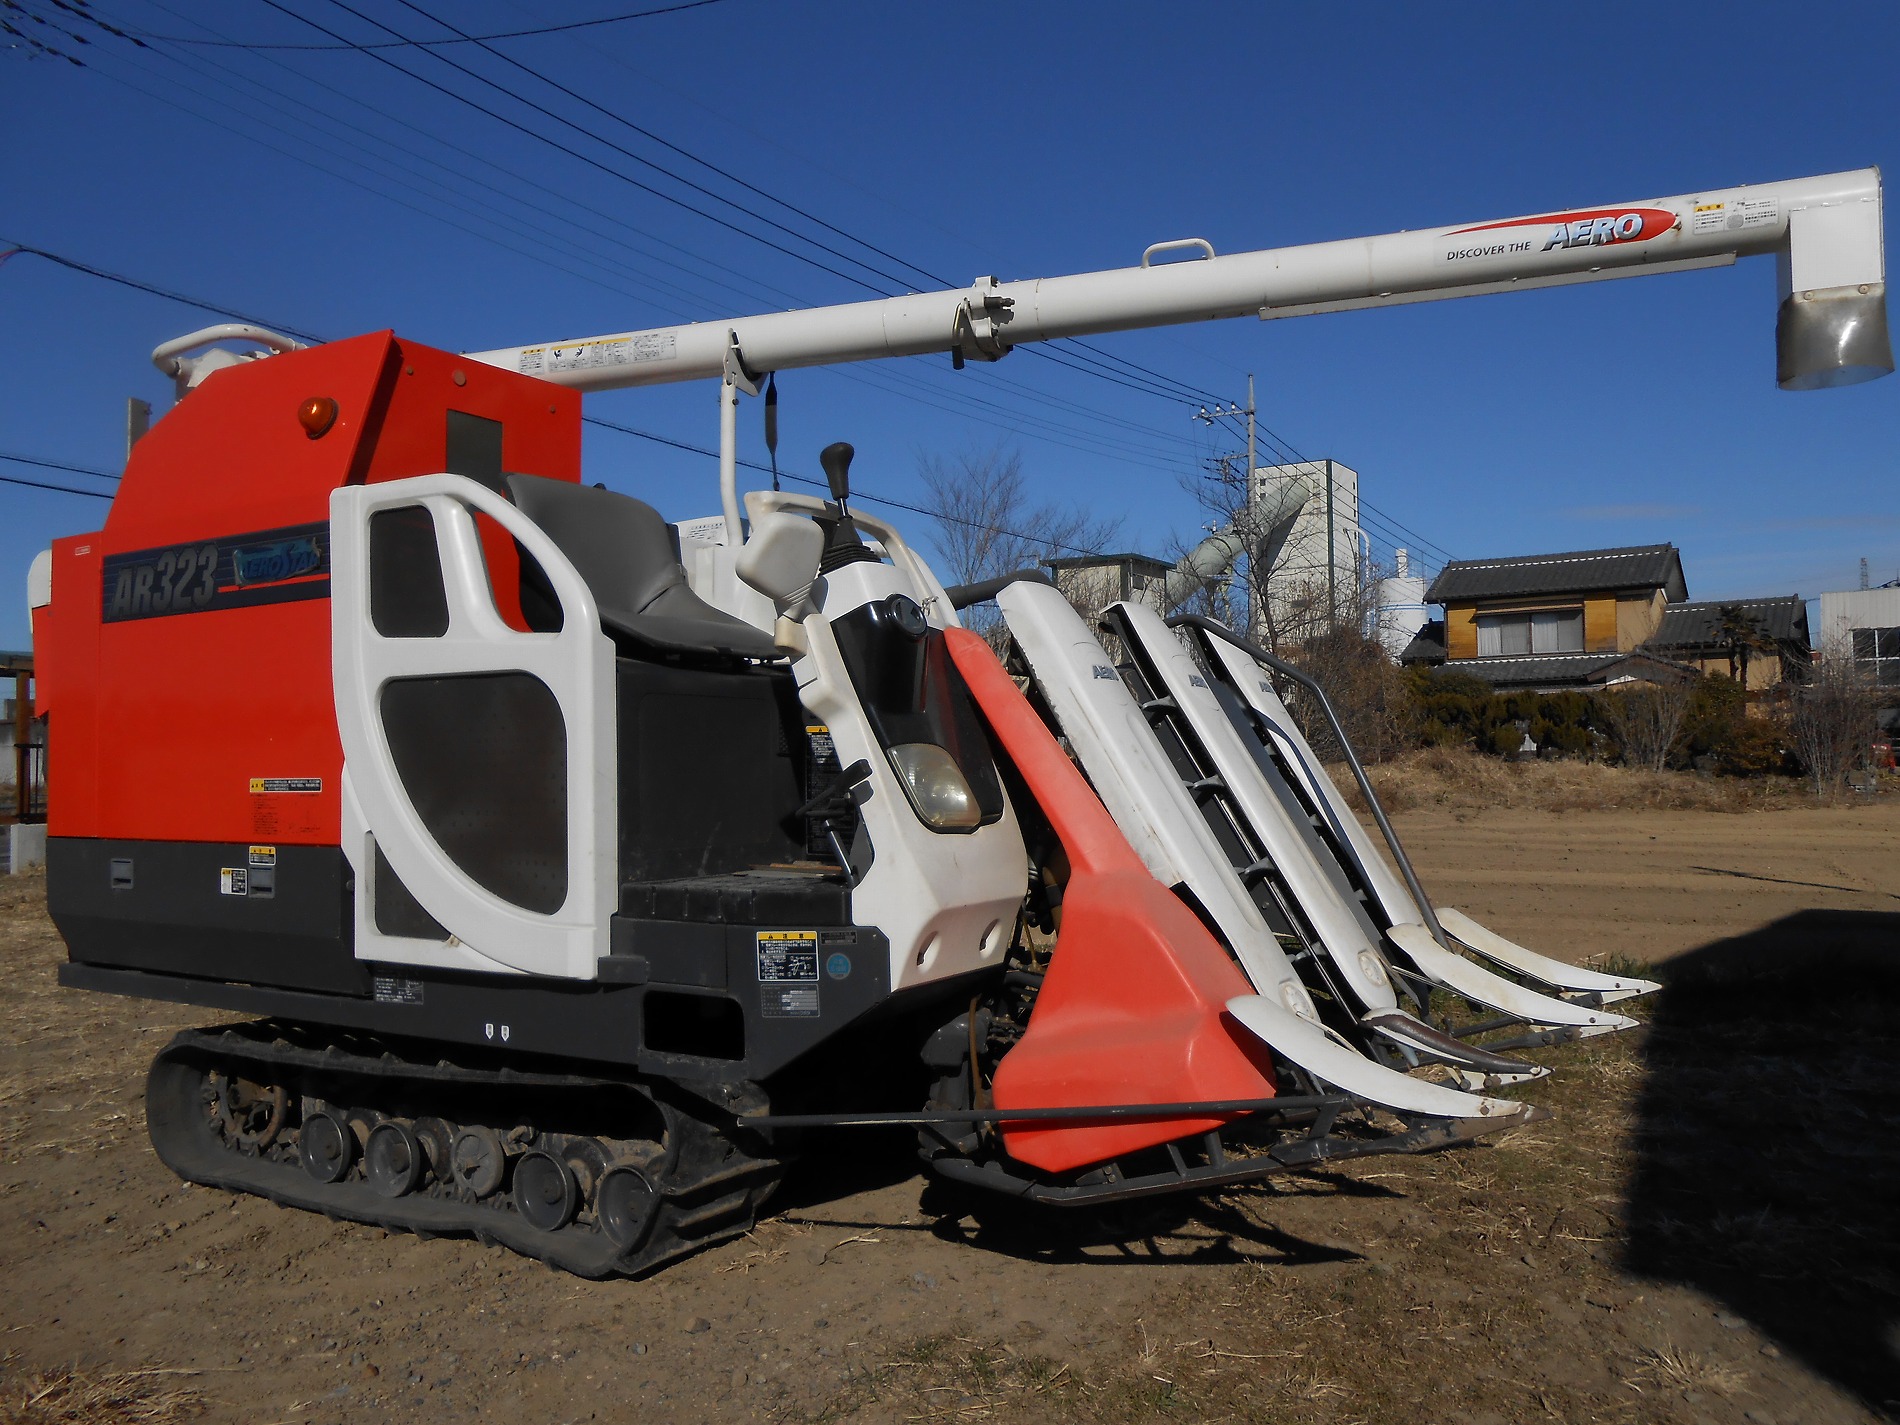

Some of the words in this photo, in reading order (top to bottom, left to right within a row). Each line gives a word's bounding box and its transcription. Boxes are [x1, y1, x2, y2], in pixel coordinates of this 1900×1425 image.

[1447, 245, 1504, 260] DISCOVER
[1509, 241, 1531, 252] THE
[1540, 213, 1643, 252] AERO
[111, 543, 218, 617] AR323
